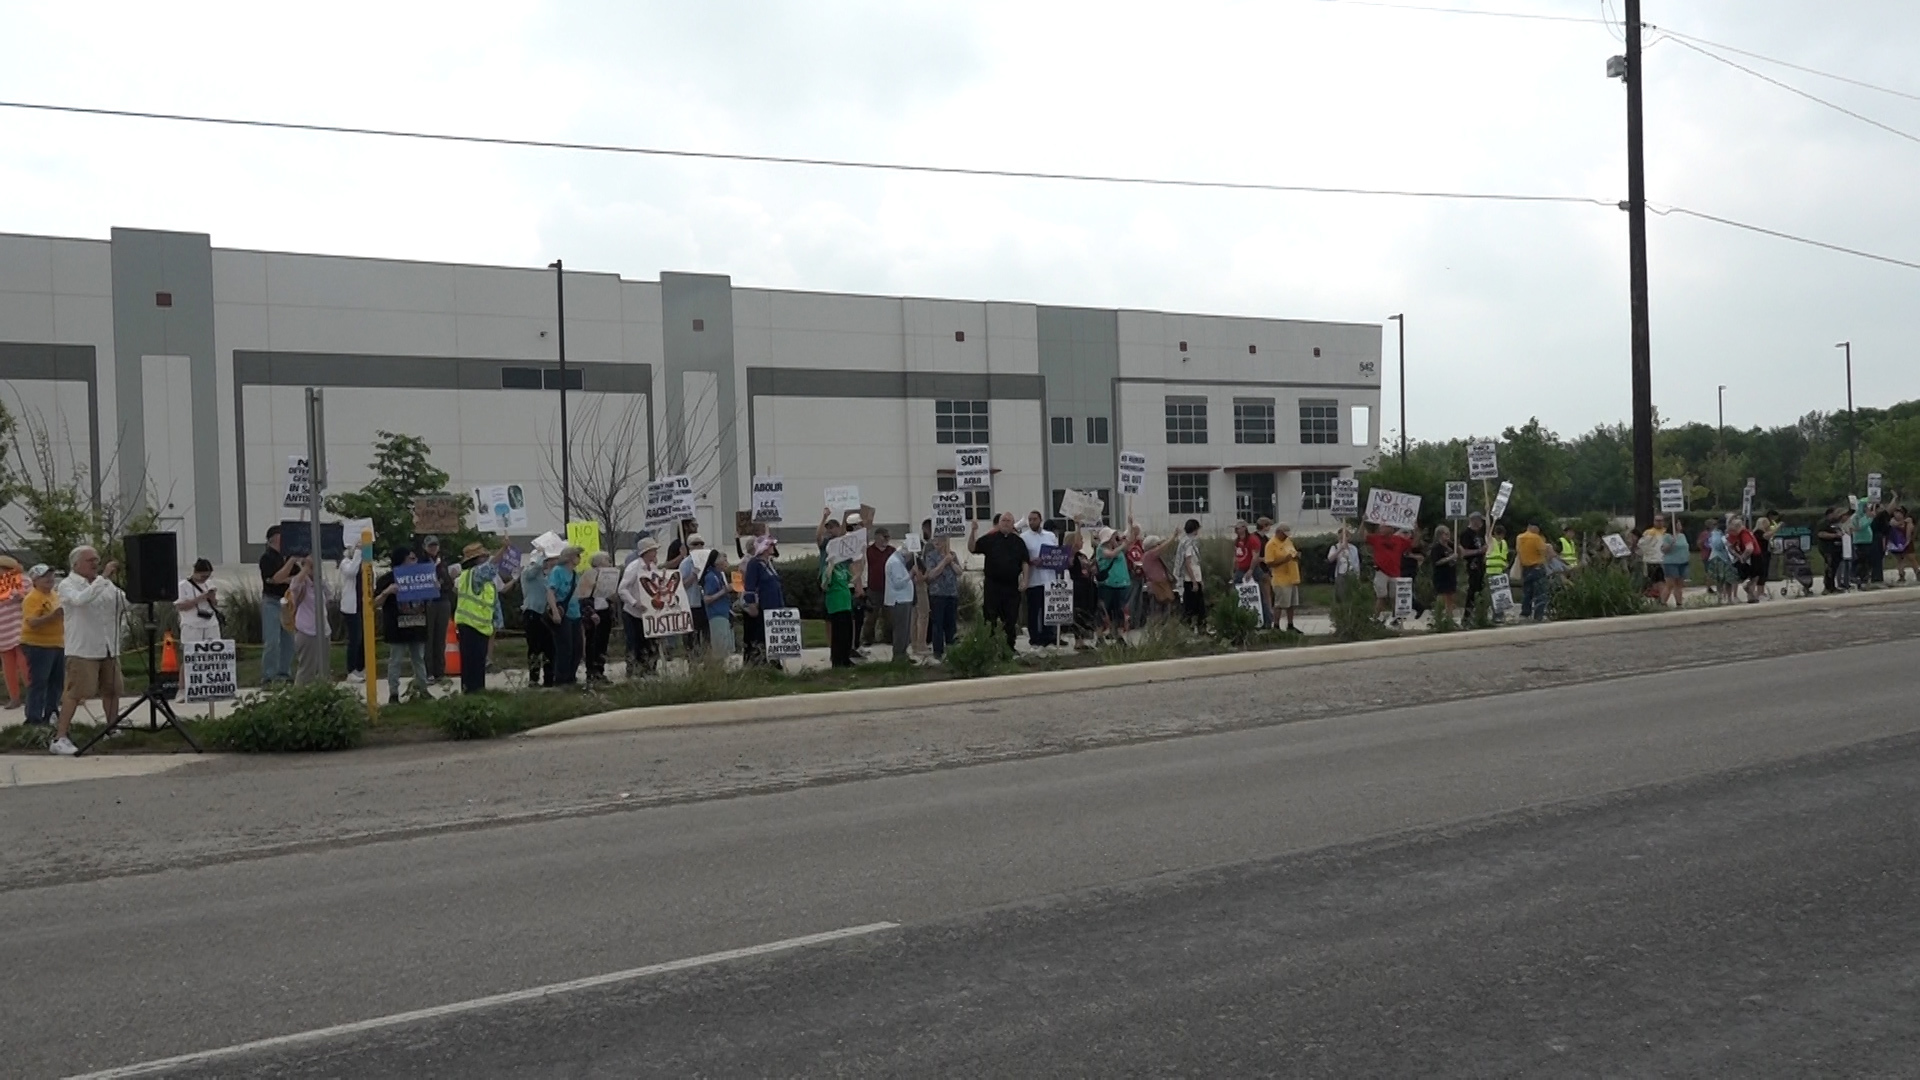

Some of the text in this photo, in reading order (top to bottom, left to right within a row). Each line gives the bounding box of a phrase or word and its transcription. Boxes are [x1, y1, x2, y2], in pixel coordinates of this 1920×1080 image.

[961, 455, 982, 466] SON
[676, 478, 689, 488] TO
[754, 482, 783, 492] ABOLIR
[939, 494, 959, 502] NO
[574, 525, 593, 538] NO
[644, 611, 695, 636] JUSTICIA
[194, 642, 225, 652] NO
[184, 653, 235, 663] DETENTION
[192, 663, 228, 672] CENTER
[190, 671, 231, 684] IN SAN
[187, 684, 236, 696] ANTONIO
